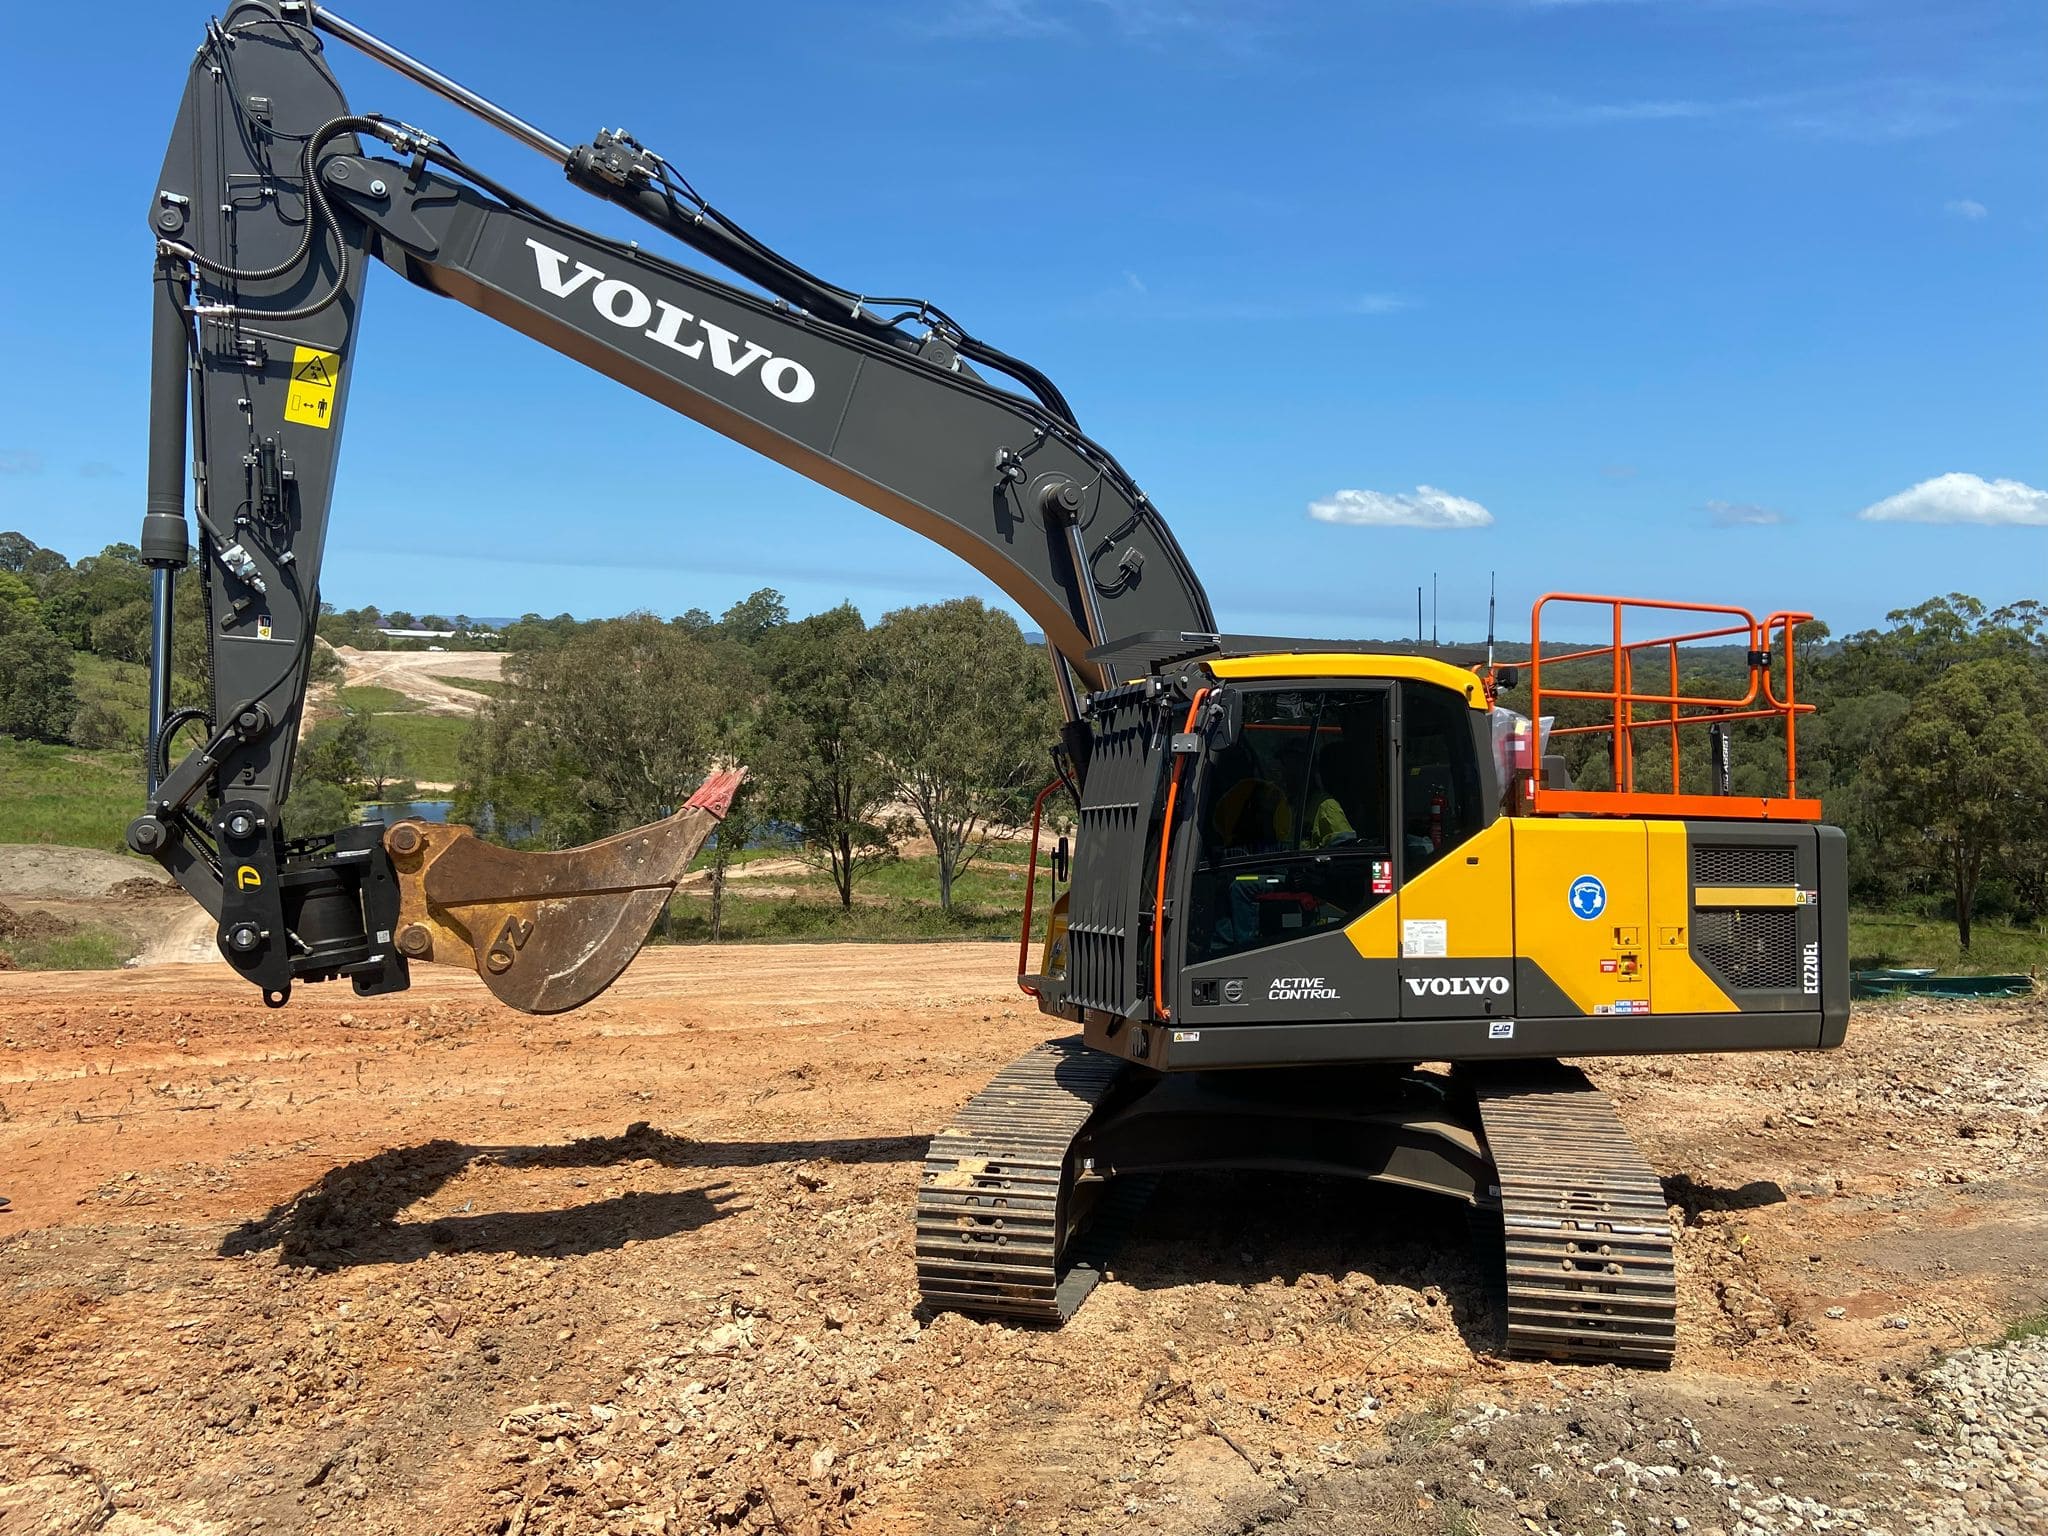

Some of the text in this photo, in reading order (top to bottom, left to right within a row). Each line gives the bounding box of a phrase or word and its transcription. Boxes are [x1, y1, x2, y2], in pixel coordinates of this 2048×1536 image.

[525, 237, 816, 404] VOLVO
[1803, 941, 1818, 994] EC220EL
[1271, 977, 1325, 989] ACTIVE
[1405, 976, 1510, 996] VOLVO
[1268, 988, 1341, 1000] CONTROL
